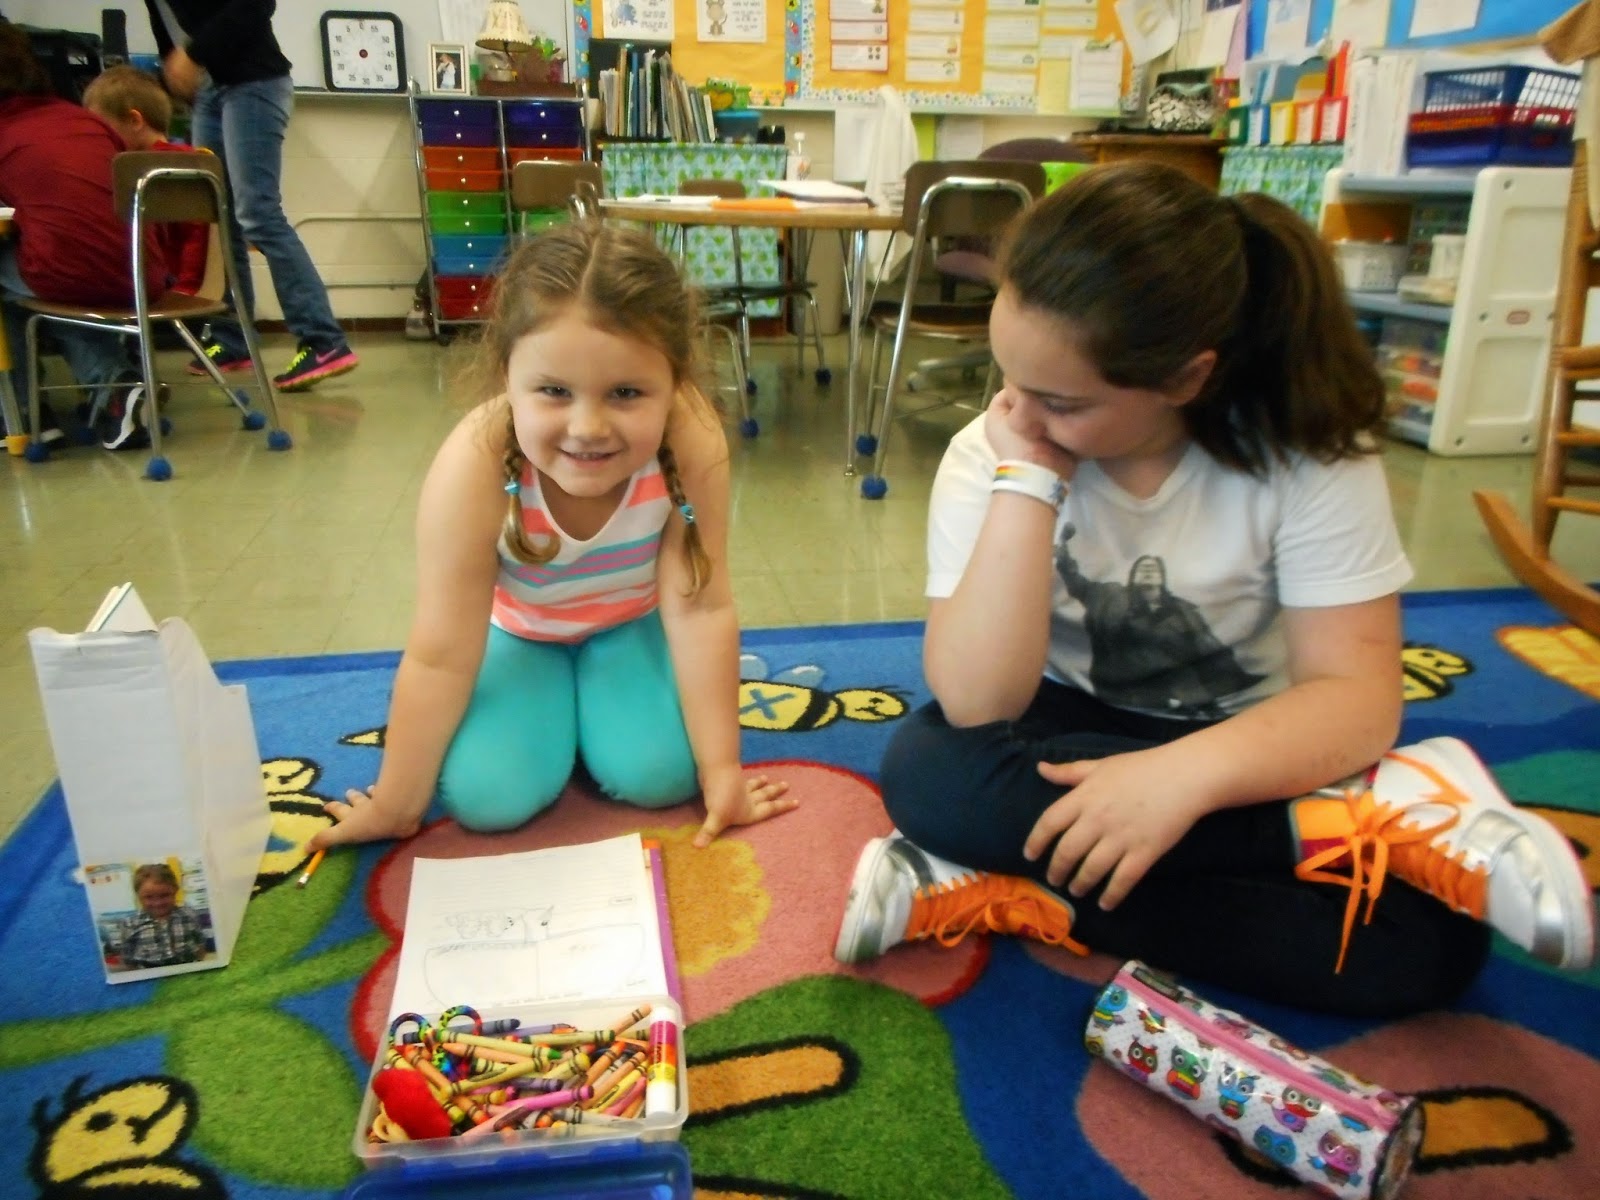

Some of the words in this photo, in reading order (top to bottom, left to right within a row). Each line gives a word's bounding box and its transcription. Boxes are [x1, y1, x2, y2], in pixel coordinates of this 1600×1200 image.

[346, 25, 351, 33] 5
[370, 25, 378, 33] 55
[335, 35, 342, 43] 10
